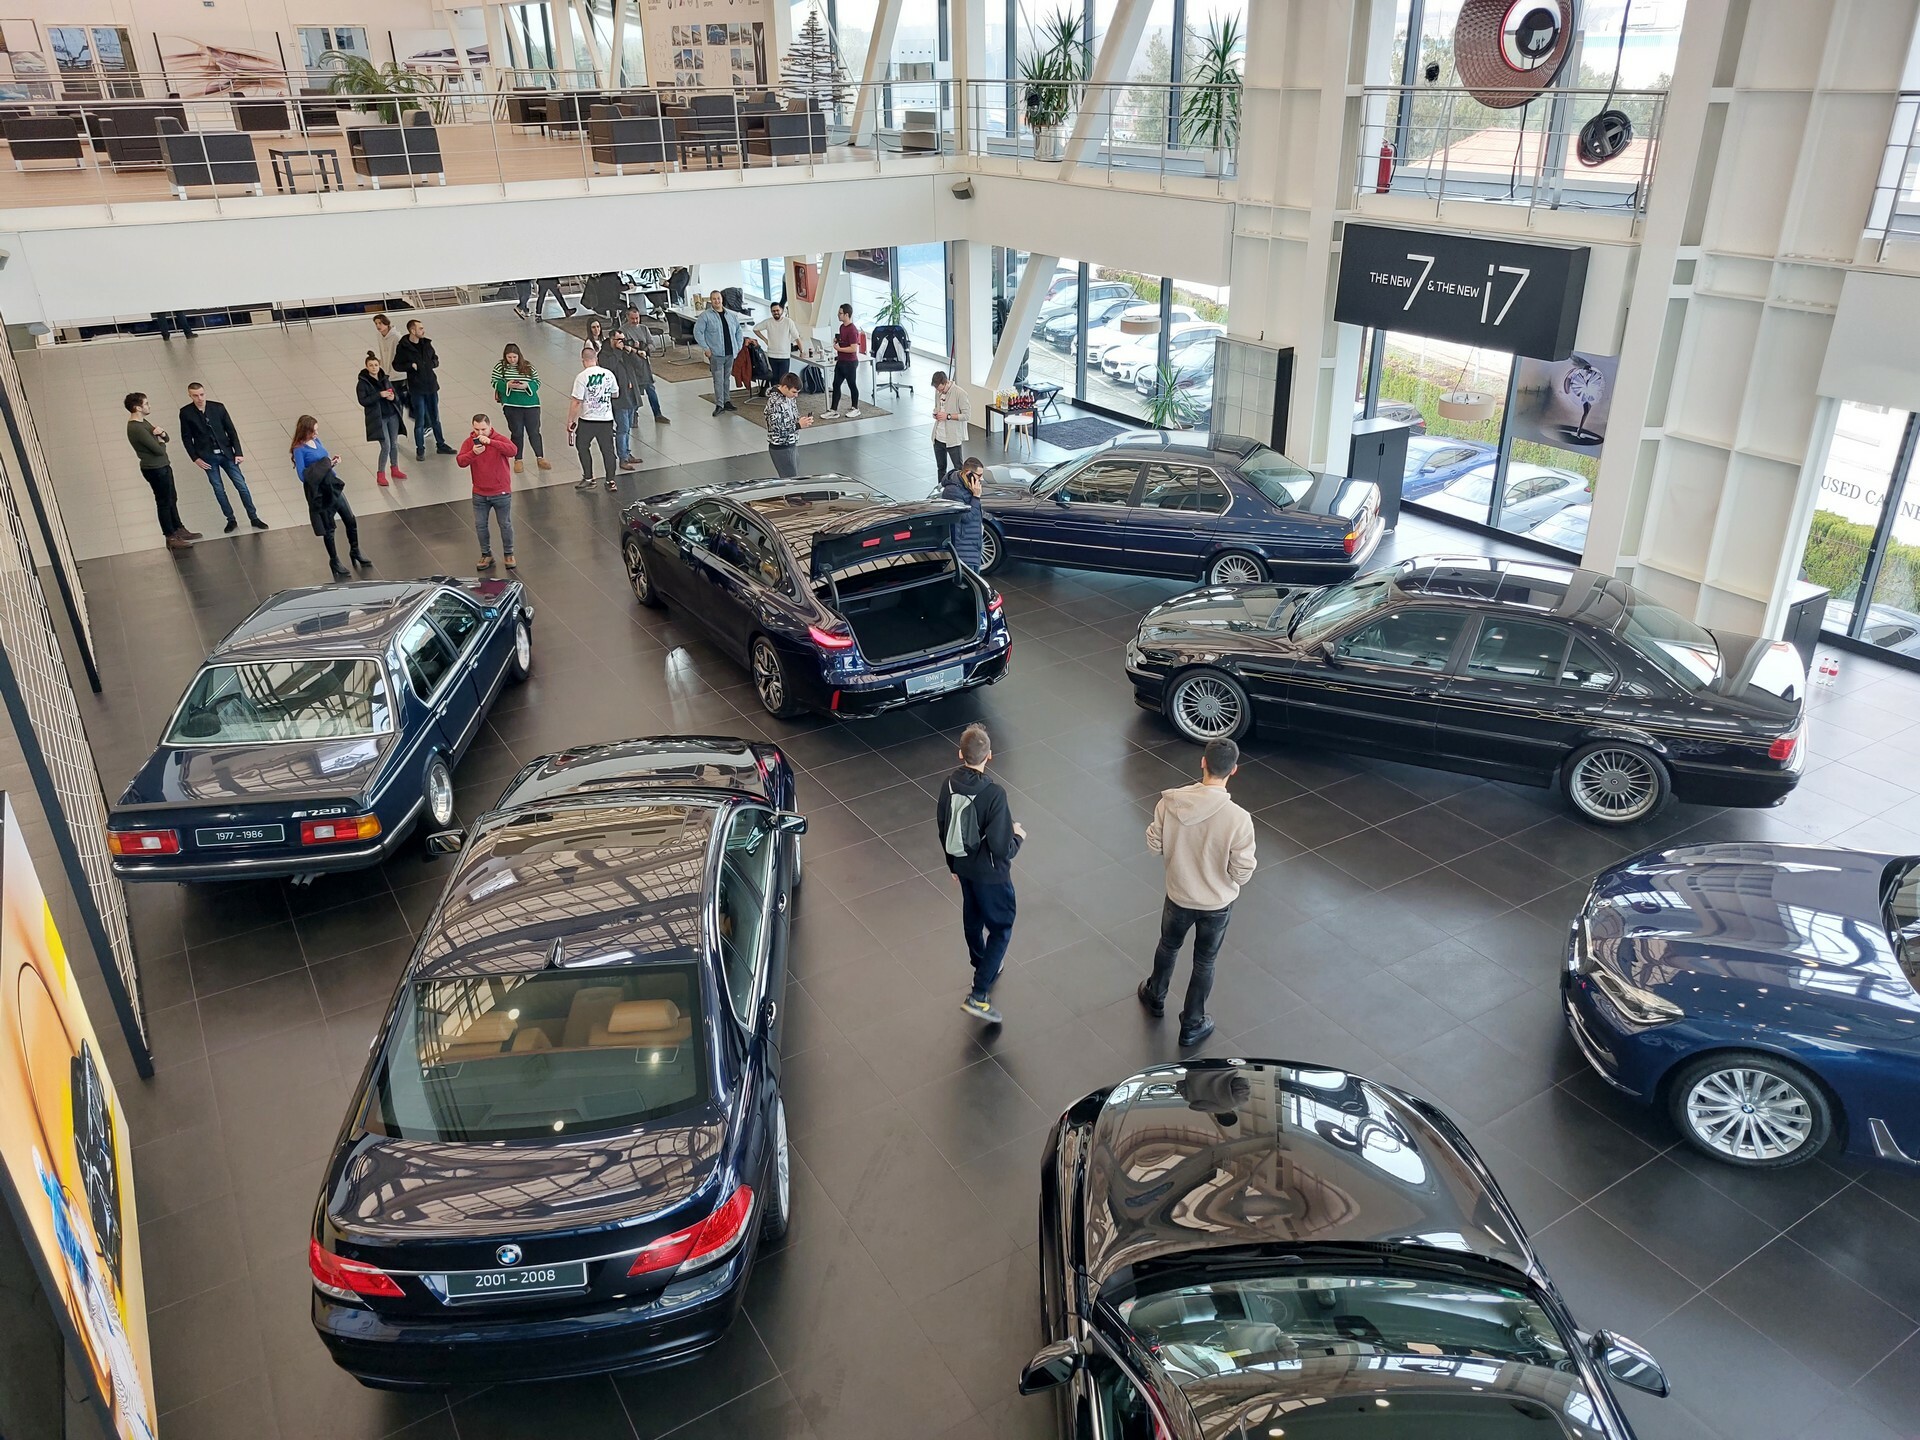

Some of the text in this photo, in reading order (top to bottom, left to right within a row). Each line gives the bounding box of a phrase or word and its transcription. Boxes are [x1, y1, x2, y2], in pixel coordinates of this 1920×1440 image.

[1369, 253, 1531, 326] THE NEW 7 & THE NEW i7
[1820, 475, 1861, 500] USED
[1865, 489, 1886, 507] CA
[307, 807, 347, 816] 728i
[216, 831, 234, 841] 1977
[242, 829, 263, 839] 1986
[475, 1273, 506, 1287] 2001
[520, 1269, 556, 1284] 2008
